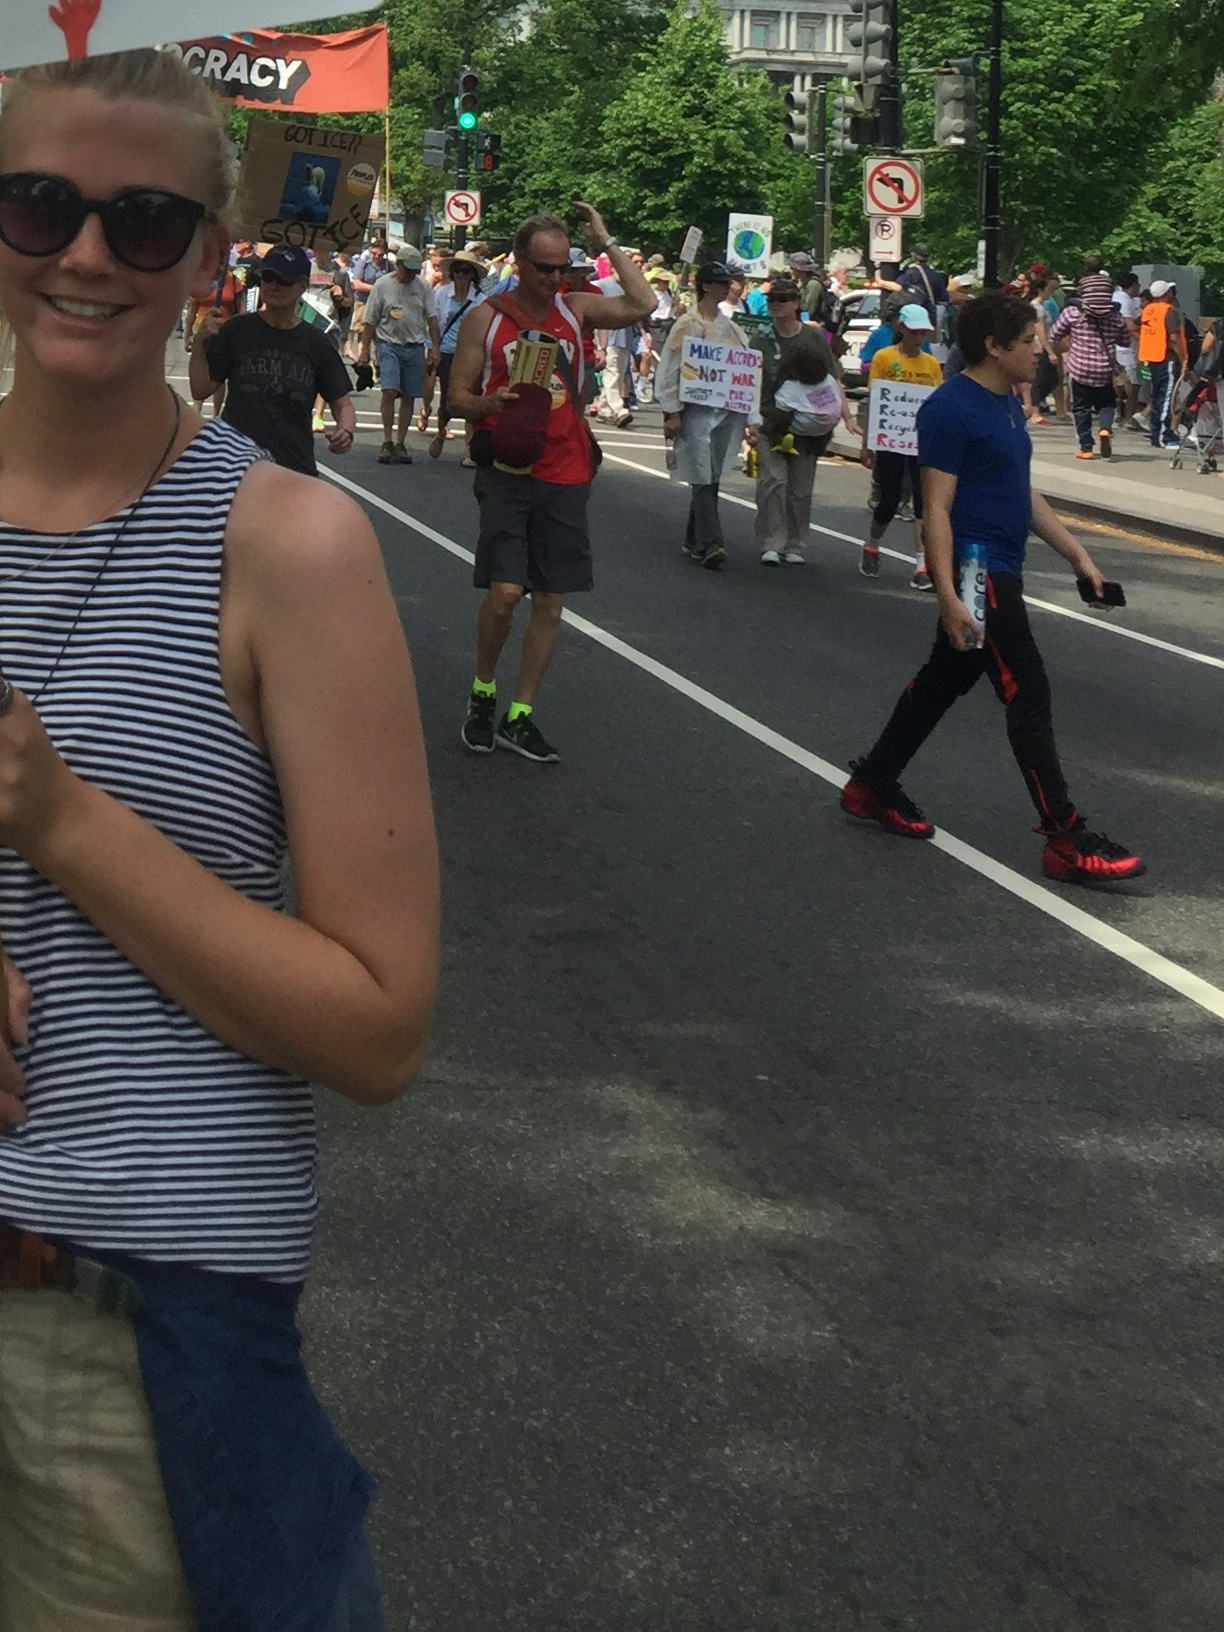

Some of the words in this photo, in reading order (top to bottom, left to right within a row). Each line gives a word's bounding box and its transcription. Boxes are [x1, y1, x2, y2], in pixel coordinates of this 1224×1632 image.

[284, 125, 317, 146] GOT
[260, 218, 325, 249] GOT
[323, 203, 369, 252] ICE
[689, 343, 723, 361] MAKE
[698, 365, 726, 382] NOT
[731, 372, 755, 387] WAR
[879, 404, 916, 417] Re-us
[974, 572, 986, 622] core
